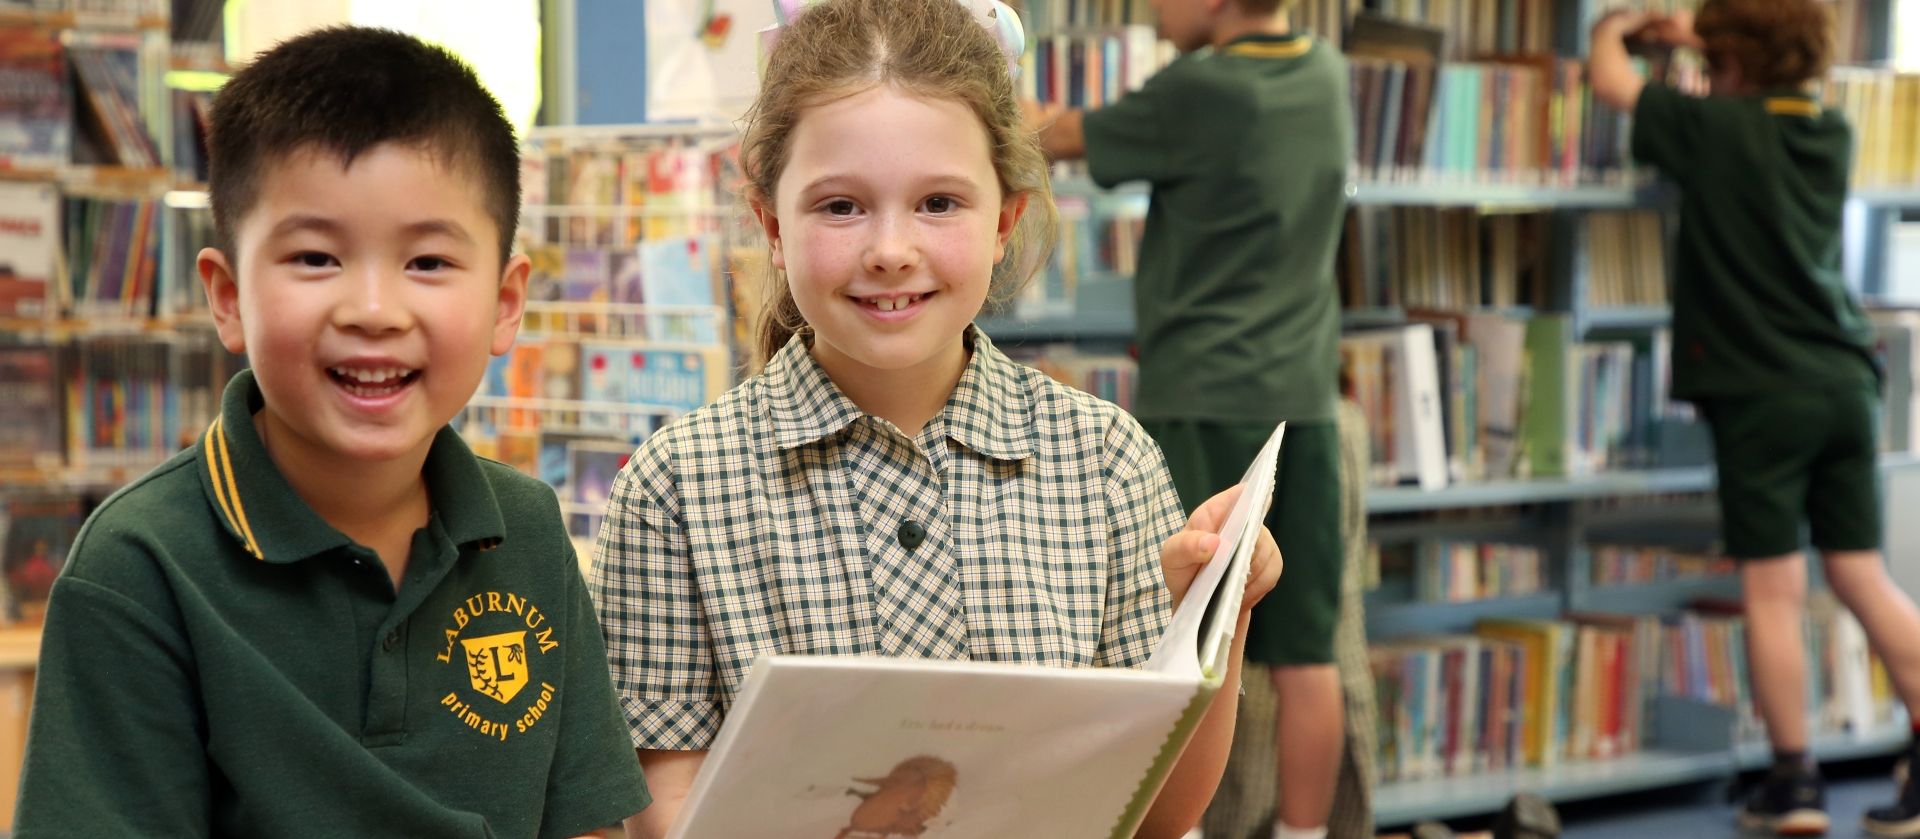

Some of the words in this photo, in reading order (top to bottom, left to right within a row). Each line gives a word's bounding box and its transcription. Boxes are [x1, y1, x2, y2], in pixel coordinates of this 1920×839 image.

[437, 591, 559, 664] LABURNUM
[489, 646, 515, 683] L
[441, 692, 509, 742] primary
[516, 682, 556, 733] school
